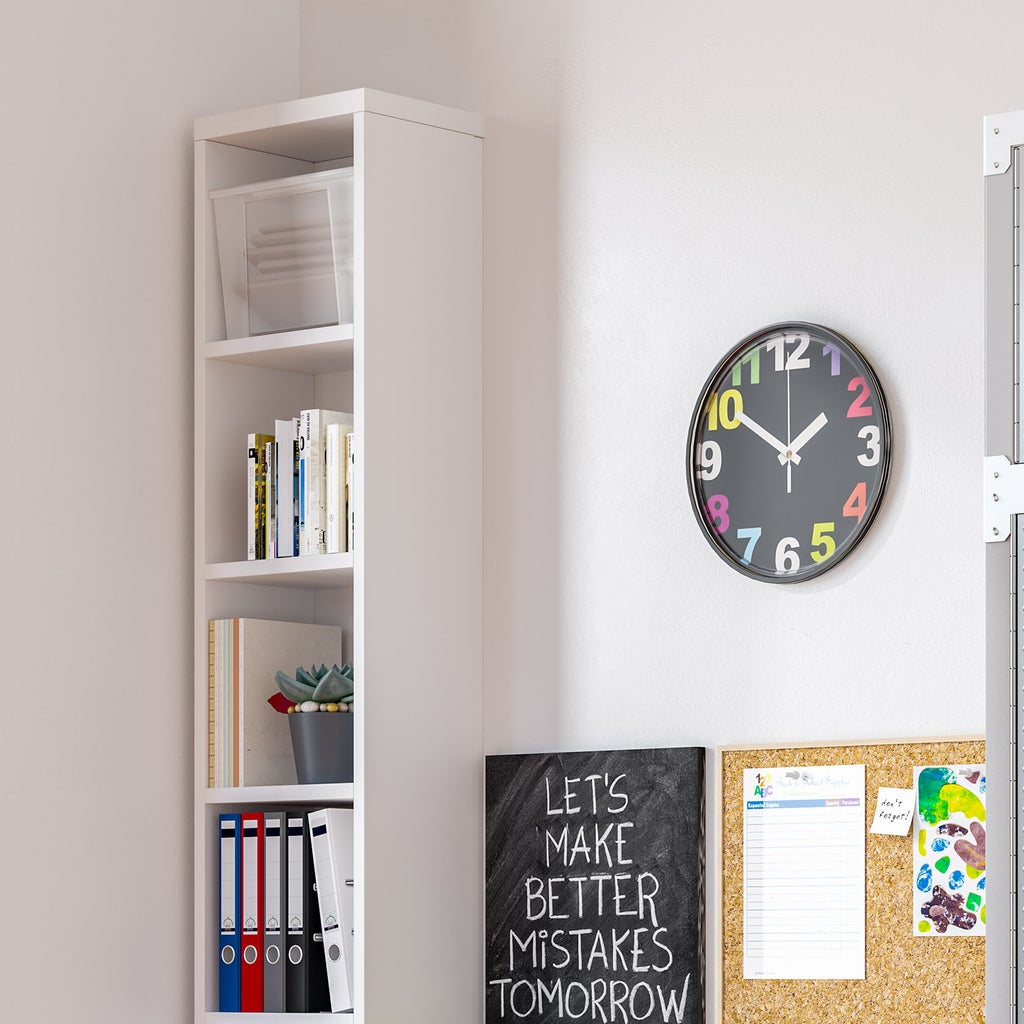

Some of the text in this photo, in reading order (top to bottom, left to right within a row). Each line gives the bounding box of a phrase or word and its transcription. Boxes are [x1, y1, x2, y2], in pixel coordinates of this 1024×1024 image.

[731, 348, 761, 387] 11
[766, 332, 811, 372] 12
[822, 343, 841, 377] 1
[704, 388, 744, 431] 10
[846, 376, 873, 419] 2
[697, 440, 723, 481] 9
[856, 424, 881, 467] 3
[706, 493, 731, 535] 8
[842, 482, 868, 525] 4
[736, 527, 762, 566] 7
[774, 536, 801, 575] 6
[809, 521, 837, 565] 5
[545, 772, 629, 816] LET'S
[754, 785, 773, 798] ABC
[545, 821, 635, 868] MAKE
[525, 871, 660, 927] BETTER
[489, 973, 691, 1024] TOMORROW
